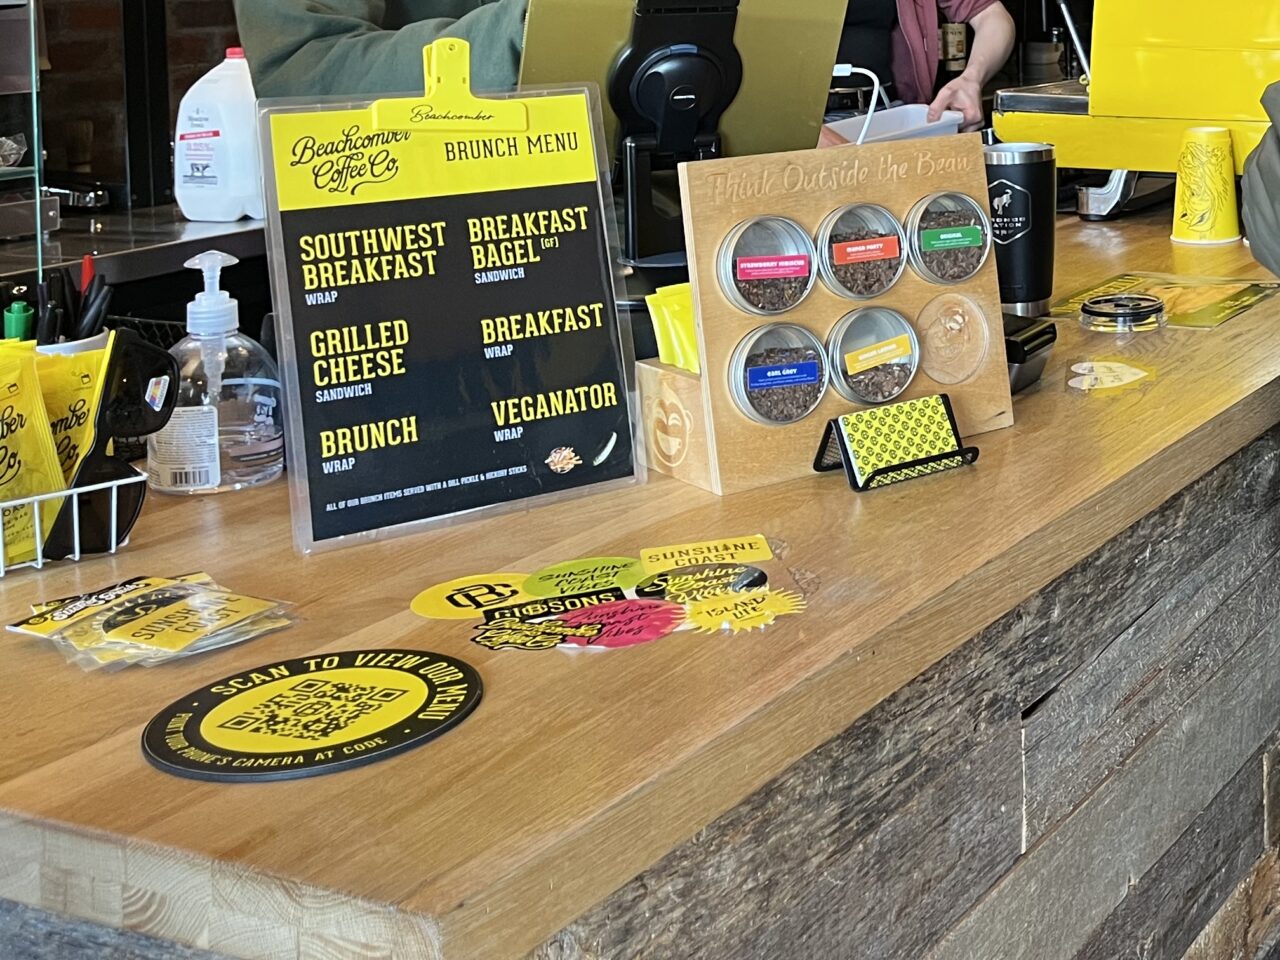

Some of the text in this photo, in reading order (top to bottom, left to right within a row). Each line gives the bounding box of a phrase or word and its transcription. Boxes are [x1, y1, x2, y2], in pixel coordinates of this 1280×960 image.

[410, 104, 495, 123] Beachcomber
[444, 131, 579, 162] BRUNCH MENU
[312, 150, 369, 194] Coffee
[707, 150, 971, 206] Think Outside the Bean
[467, 206, 588, 243] BREAKFAST
[300, 221, 447, 262] SOUTHWEST
[471, 239, 541, 269] BAGEL
[302, 250, 437, 291] BREAKFAST
[474, 267, 525, 284] SANDWICH
[305, 290, 339, 307] WRAP
[481, 303, 604, 344] BREAKFAST
[310, 319, 410, 358] GRILLED
[484, 345, 514, 360] WRAP
[313, 348, 407, 387] CHEESE
[315, 383, 373, 404] SANDWICH
[490, 382, 618, 427] VEGANATOR
[320, 416, 418, 458] BRUNCH
[493, 427, 523, 442] WRAP
[322, 458, 355, 474] WRAP
[648, 542, 760, 563] SUNSHINE
[674, 551, 738, 566] COAST
[538, 563, 637, 582] SUNSHINE
[554, 571, 620, 587] COAST
[644, 566, 748, 592] Sunshine
[671, 575, 738, 592] Coast
[131, 597, 241, 640] SUNSHNE
[494, 592, 616, 619] GIBSONS
[706, 595, 769, 618] ISLAND
[210, 653, 468, 721] SCAN TO VIEW OUR MENU
[231, 754, 304, 768] CAMERA
[314, 749, 335, 762] AT
[342, 736, 388, 756] CODE
